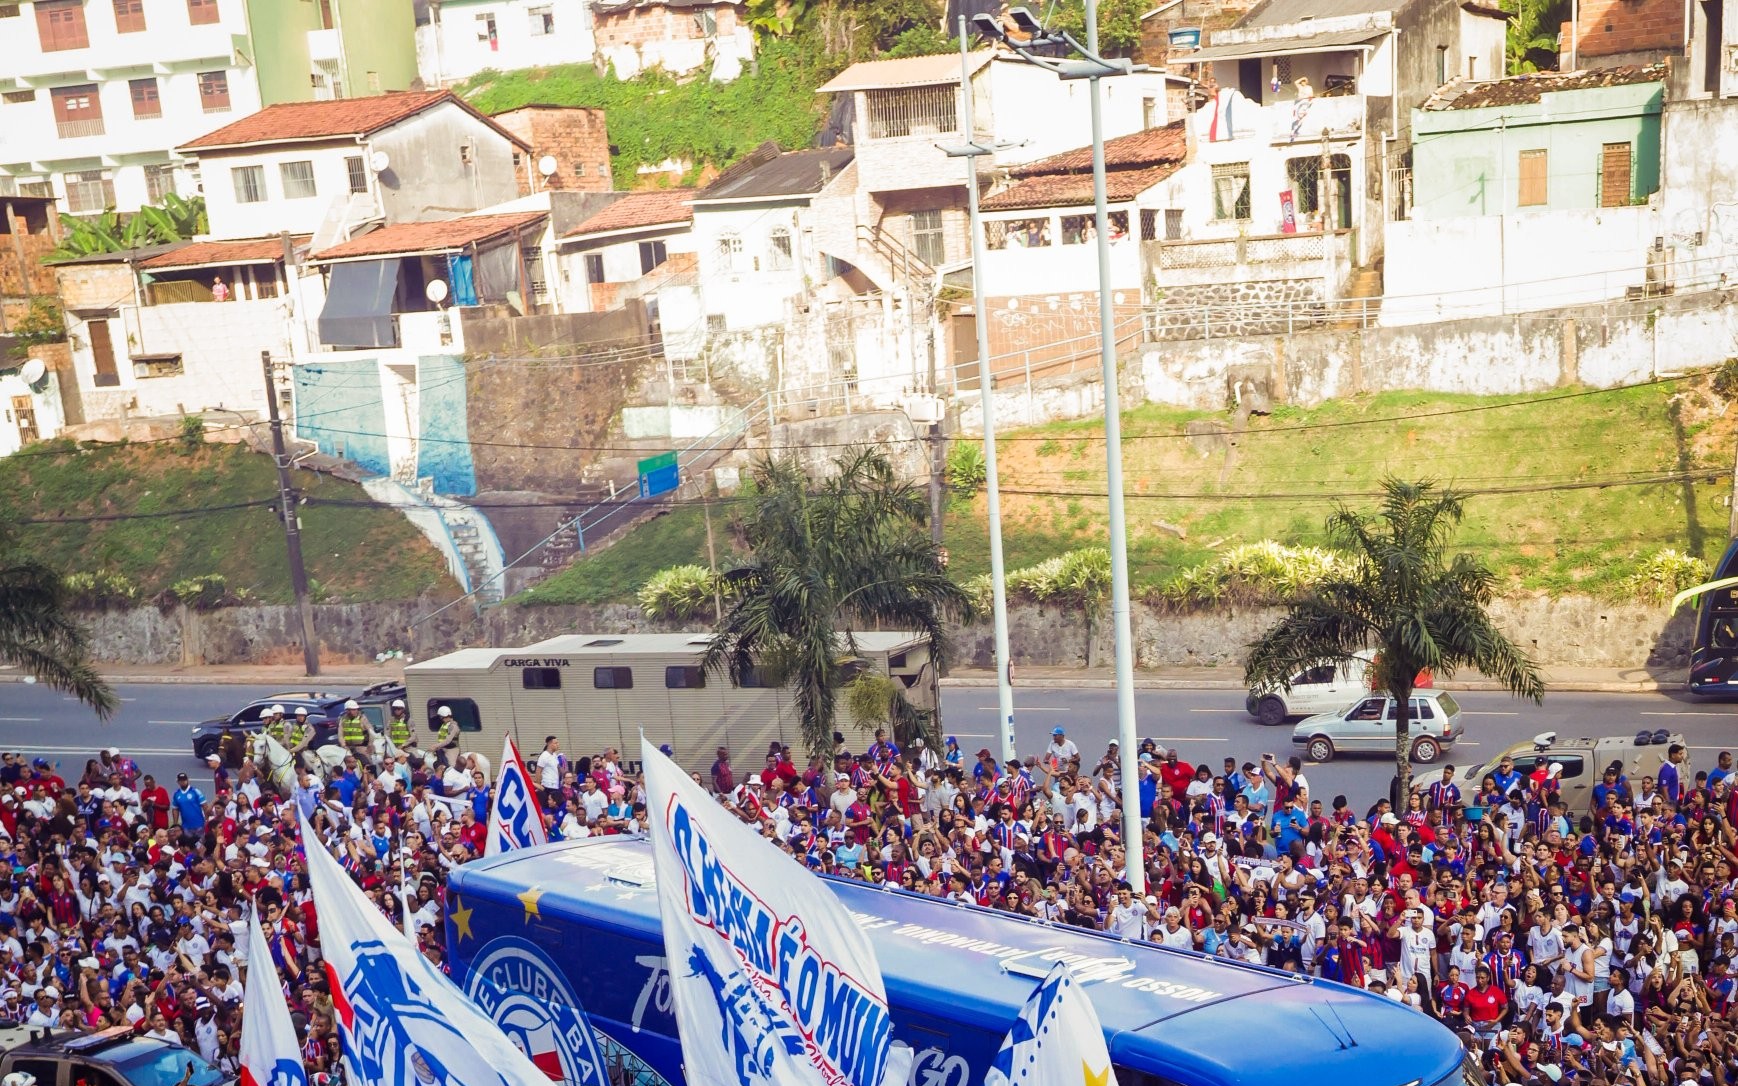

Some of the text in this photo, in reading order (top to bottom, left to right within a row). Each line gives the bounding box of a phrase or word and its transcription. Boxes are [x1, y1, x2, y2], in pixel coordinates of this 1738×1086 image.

[504, 658, 570, 668] CARGA VIVA
[492, 962, 564, 1023] CLUBE
[1121, 977, 1223, 1002] NOSSO
